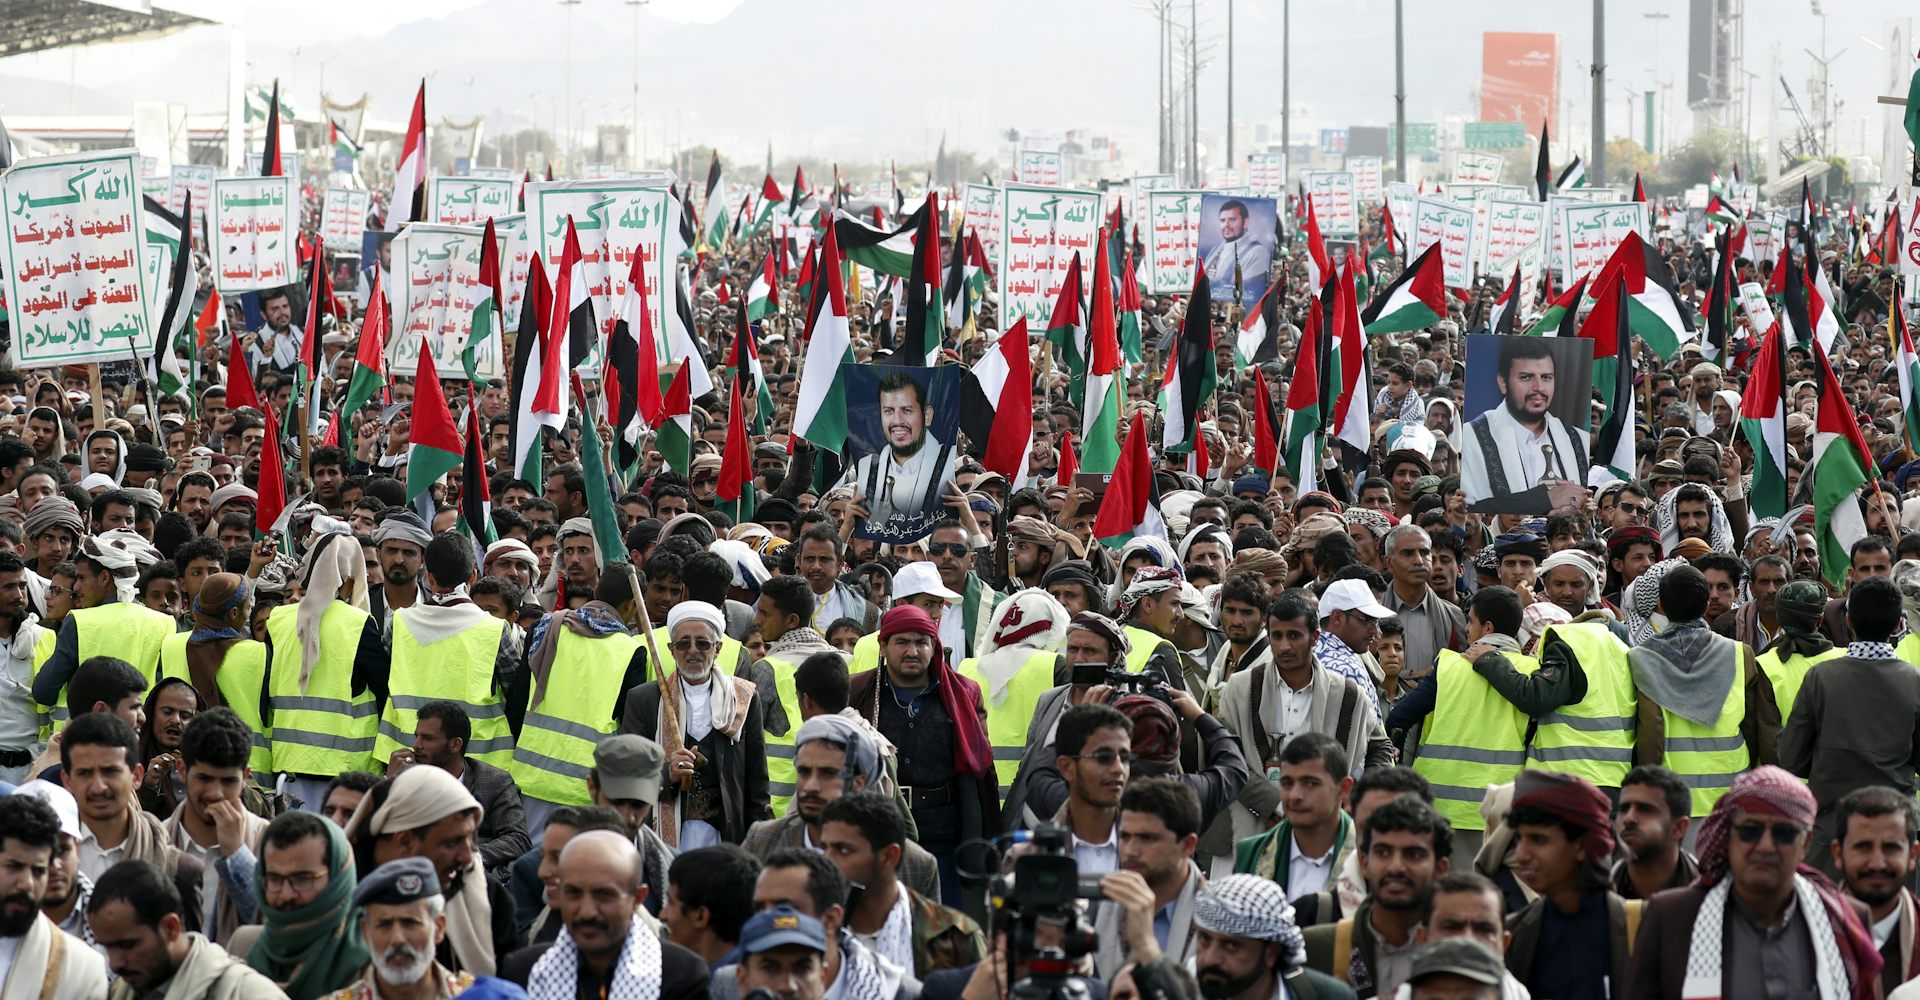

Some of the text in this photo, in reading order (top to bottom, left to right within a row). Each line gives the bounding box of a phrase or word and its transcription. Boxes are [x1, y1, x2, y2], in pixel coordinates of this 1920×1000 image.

[11, 165, 97, 220] أكبر
[95, 167, 129, 200] الله
[440, 184, 508, 208] الله أكبر
[220, 186, 283, 212] قاطعوا
[618, 197, 660, 229] الله
[1010, 195, 1096, 227] الله أكبر
[80, 214, 130, 239] الموت
[1572, 209, 1637, 235] الله أكبر
[410, 236, 465, 268] أكبر
[1059, 233, 1092, 250] الموت
[85, 248, 134, 273] الموت
[23, 283, 138, 316] اللعنة على اليهود
[1008, 279, 1040, 297] اليهود
[25, 313, 144, 354] النصر للإسلام
